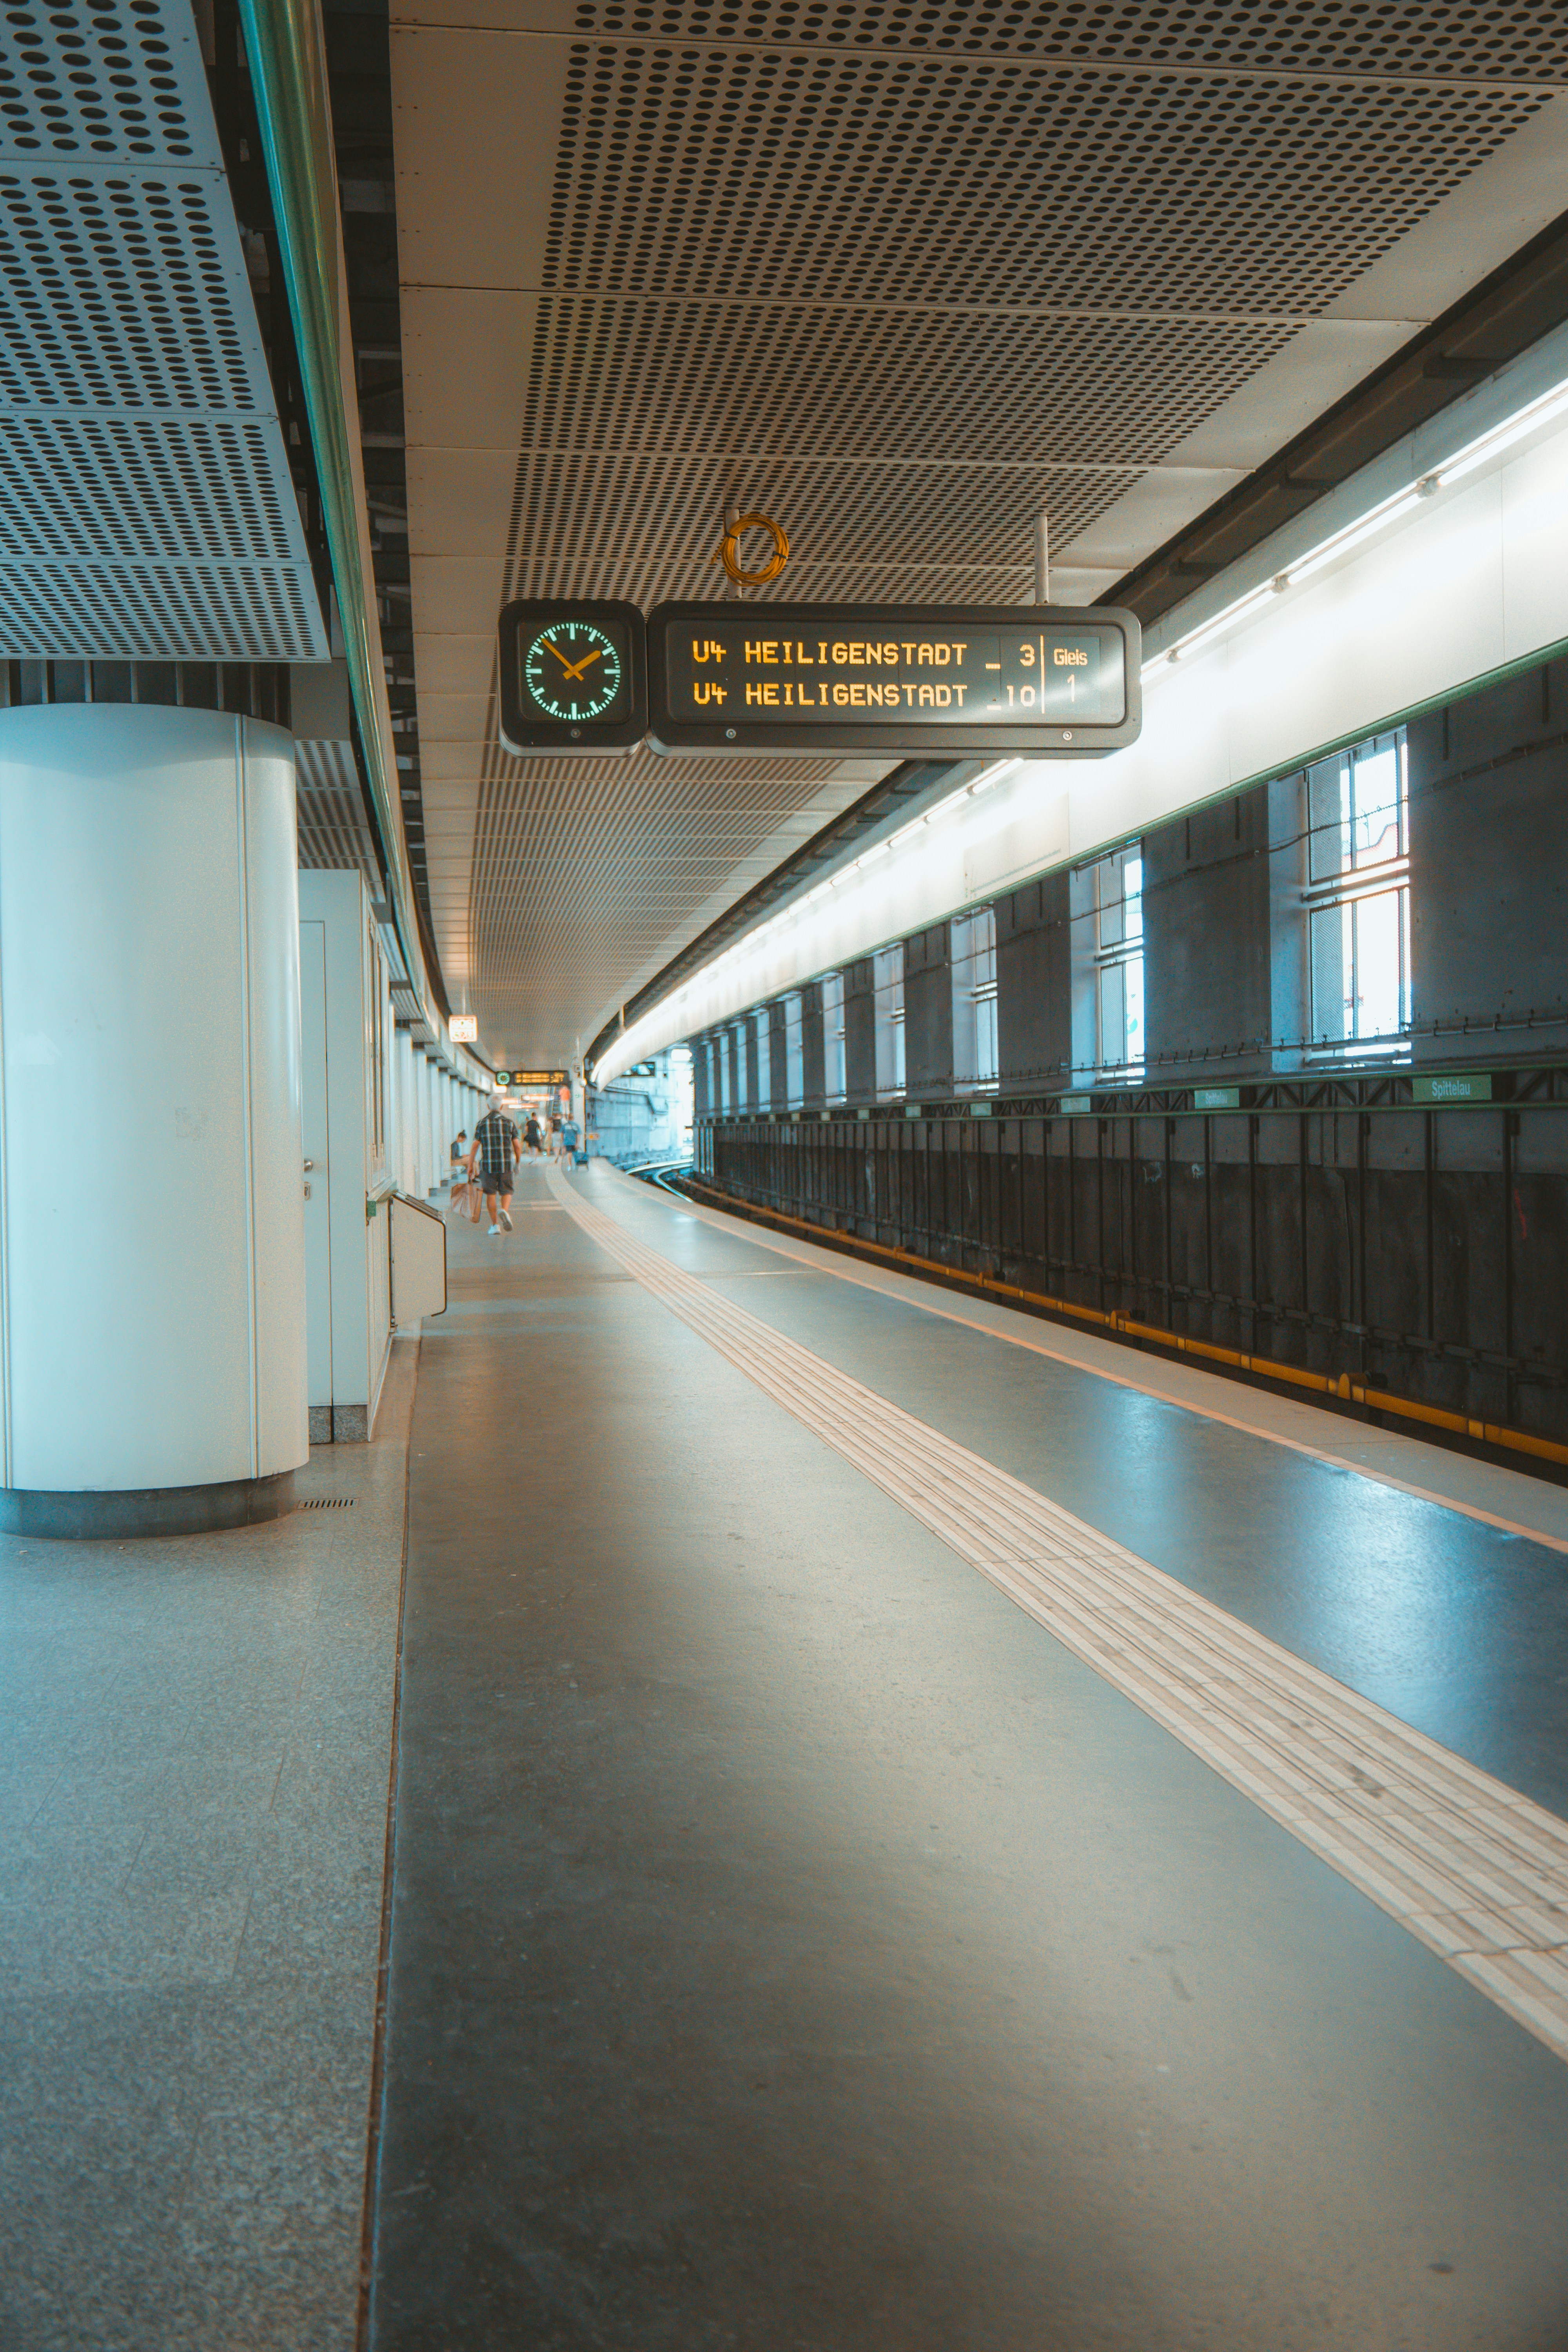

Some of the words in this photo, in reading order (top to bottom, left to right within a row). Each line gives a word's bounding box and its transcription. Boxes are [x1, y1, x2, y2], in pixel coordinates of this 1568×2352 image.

[693, 640, 726, 663] U4
[745, 641, 967, 665] HEILIGENSTADT
[1019, 644, 1035, 666] 3
[1053, 648, 1087, 666] Gleis
[694, 682, 727, 705] U4
[746, 683, 968, 707] HEILIGENSTADT
[1006, 685, 1035, 706] 10
[1067, 674, 1075, 702] 1
[1432, 1080, 1470, 1100] Spittelau
